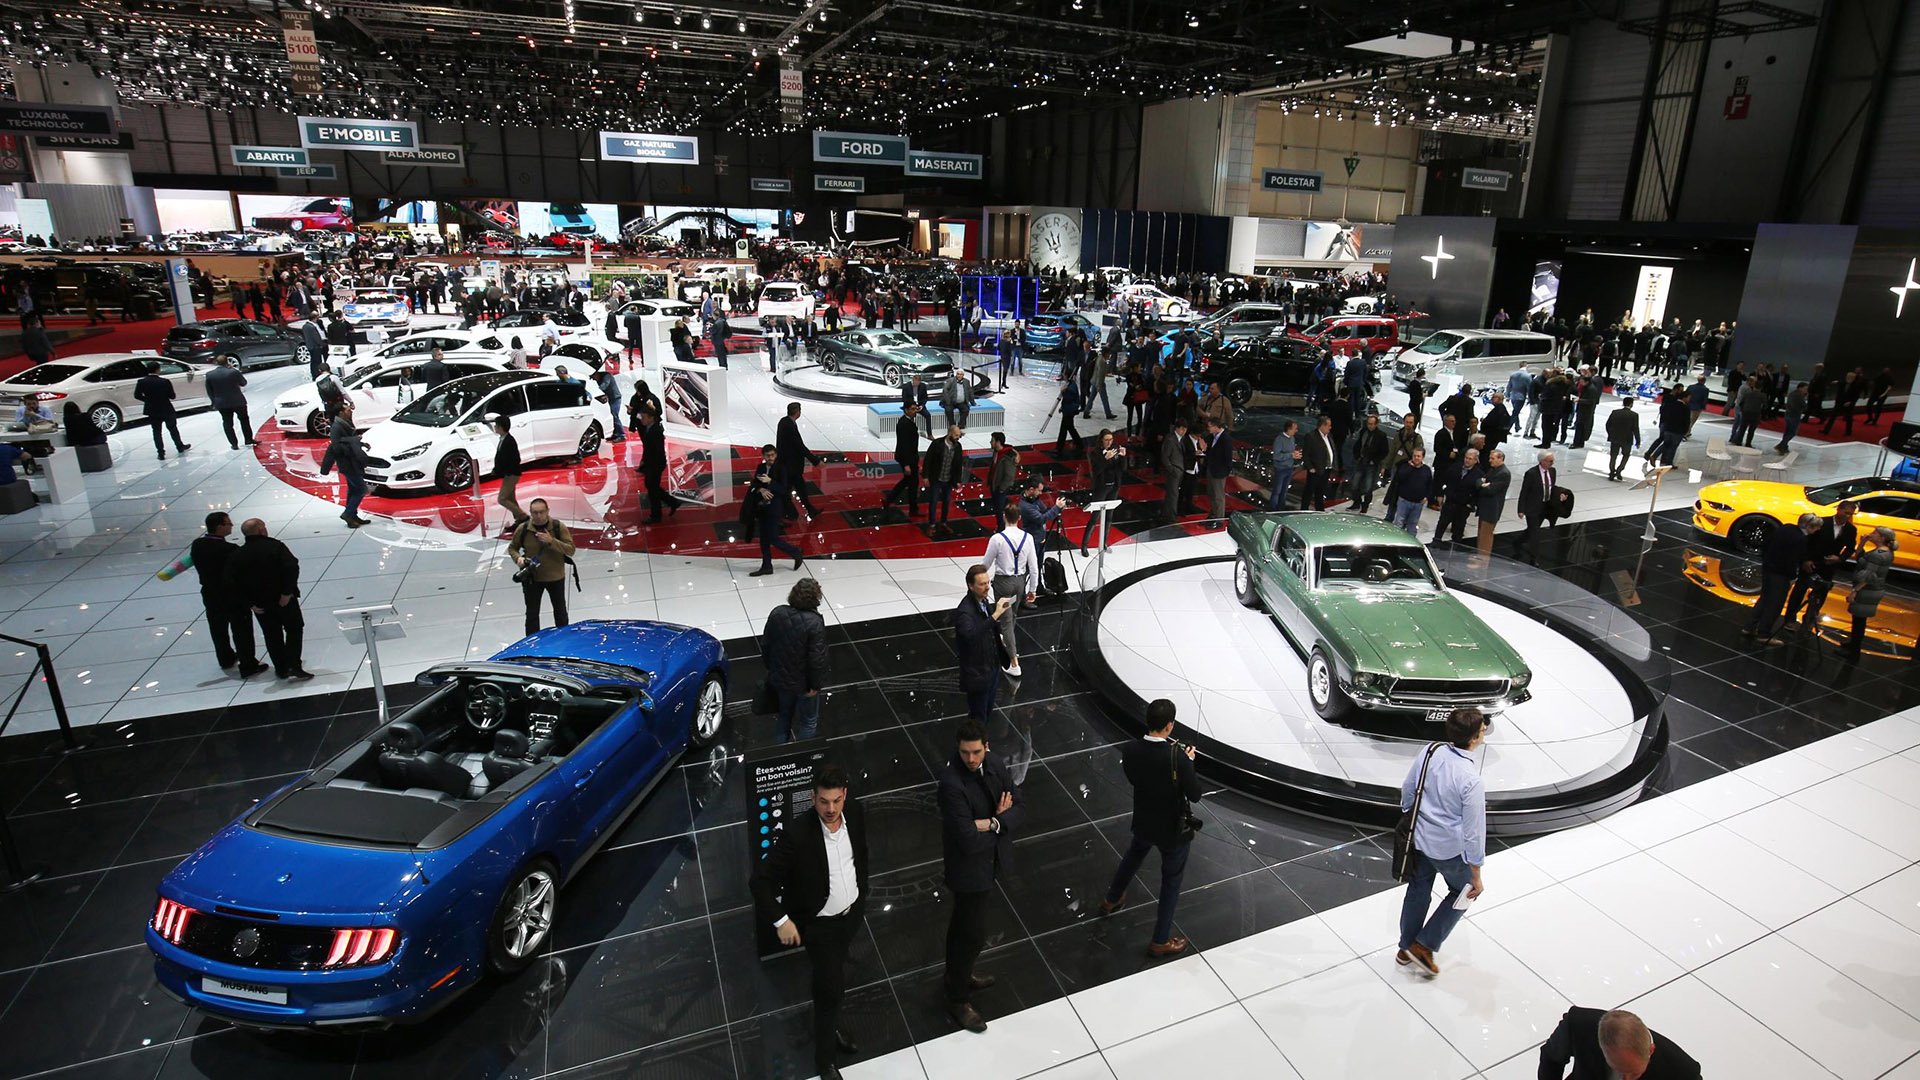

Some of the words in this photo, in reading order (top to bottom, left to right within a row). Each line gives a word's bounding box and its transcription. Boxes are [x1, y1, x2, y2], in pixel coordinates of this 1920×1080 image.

[294, 21, 303, 31] 5
[288, 44, 316, 54] 5100
[782, 82, 802, 91] 5200
[19, 110, 70, 120] LUXARIA
[7, 119, 85, 129] TECHNOLOGY
[318, 127, 401, 143] E'MOBILE
[642, 141, 677, 149] NATUREL
[841, 140, 884, 156] FORD
[246, 151, 296, 162] ABARTH
[387, 150, 416, 159] ALFA
[417, 151, 457, 160] ROMEO
[637, 148, 667, 156] BIOGAZ
[915, 158, 973, 171] MASERATI
[296, 167, 317, 176] JEEP
[824, 179, 856, 189] FERRARI
[1271, 175, 1316, 188] POLESTAR
[1472, 175, 1500, 184] McLAREN
[756, 763, 796, 775] Êtes-vous
[768, 772, 784, 780] bon
[785, 766, 813, 777] voisin?
[220, 981, 268, 995] MUSTANG
